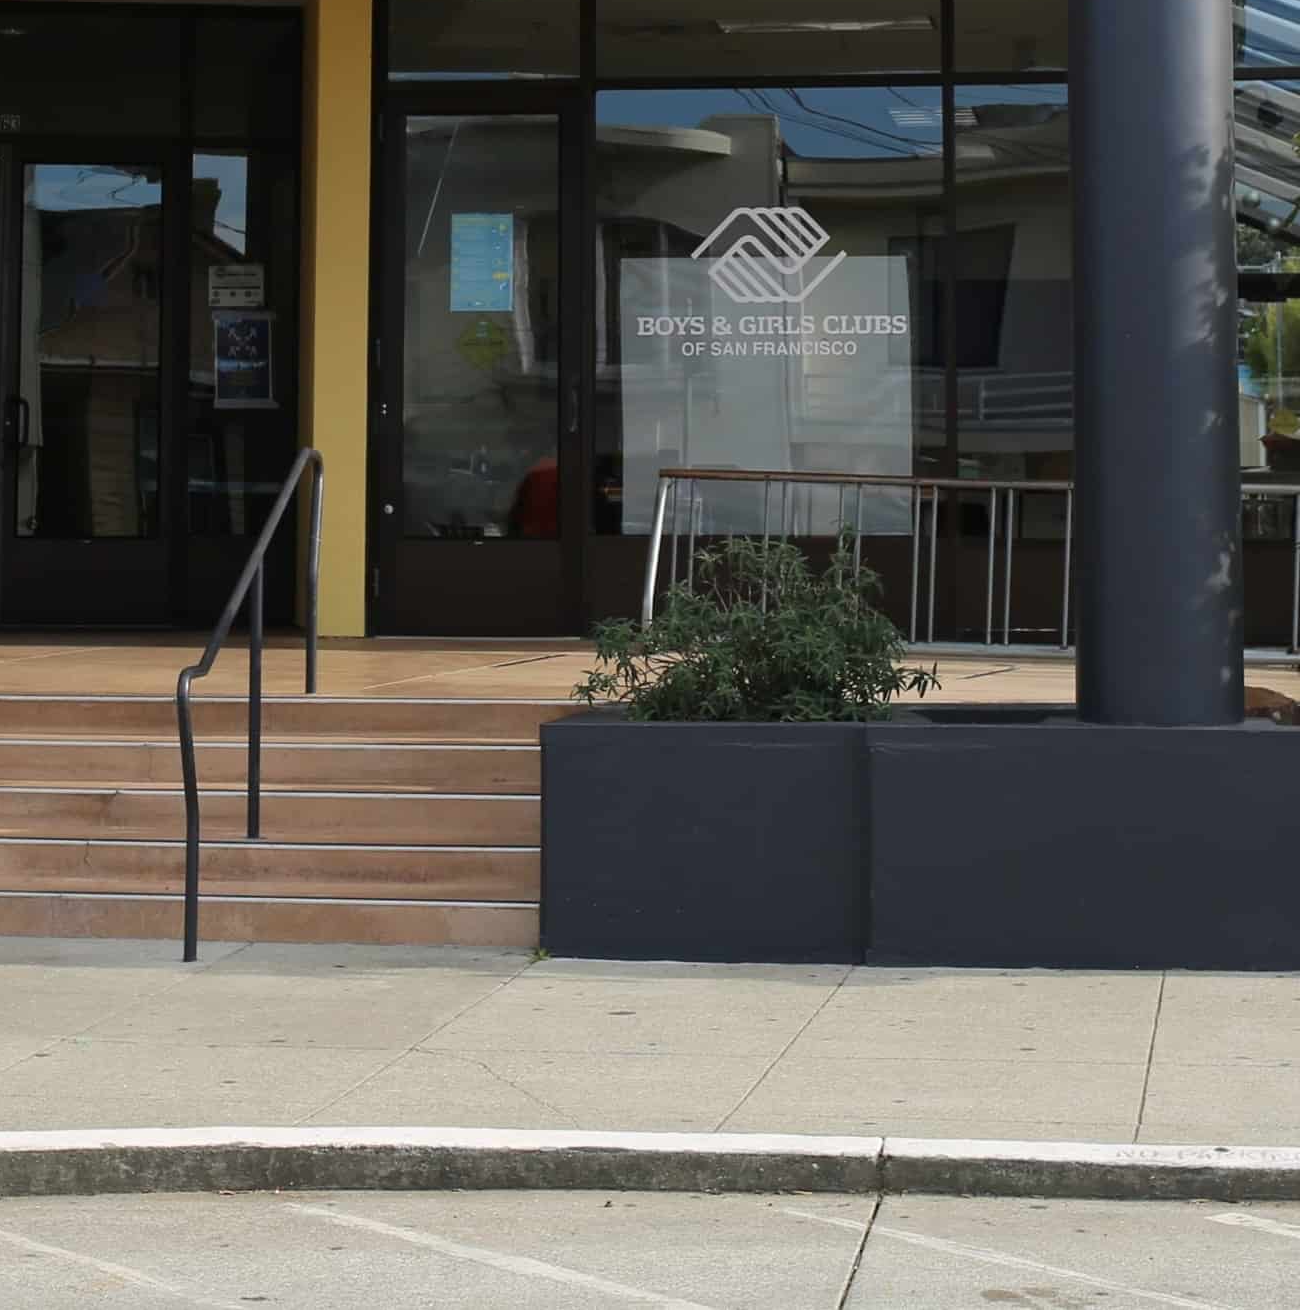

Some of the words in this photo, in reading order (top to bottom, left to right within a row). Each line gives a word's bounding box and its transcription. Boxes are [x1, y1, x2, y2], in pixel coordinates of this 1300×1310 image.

[636, 316, 705, 336] BOYS
[712, 316, 732, 335] &
[739, 315, 815, 335] GIRLS
[823, 315, 908, 335] CLUBS
[682, 342, 705, 356] OF
[711, 341, 748, 356] SAN
[753, 340, 857, 356] FRANCISCO
